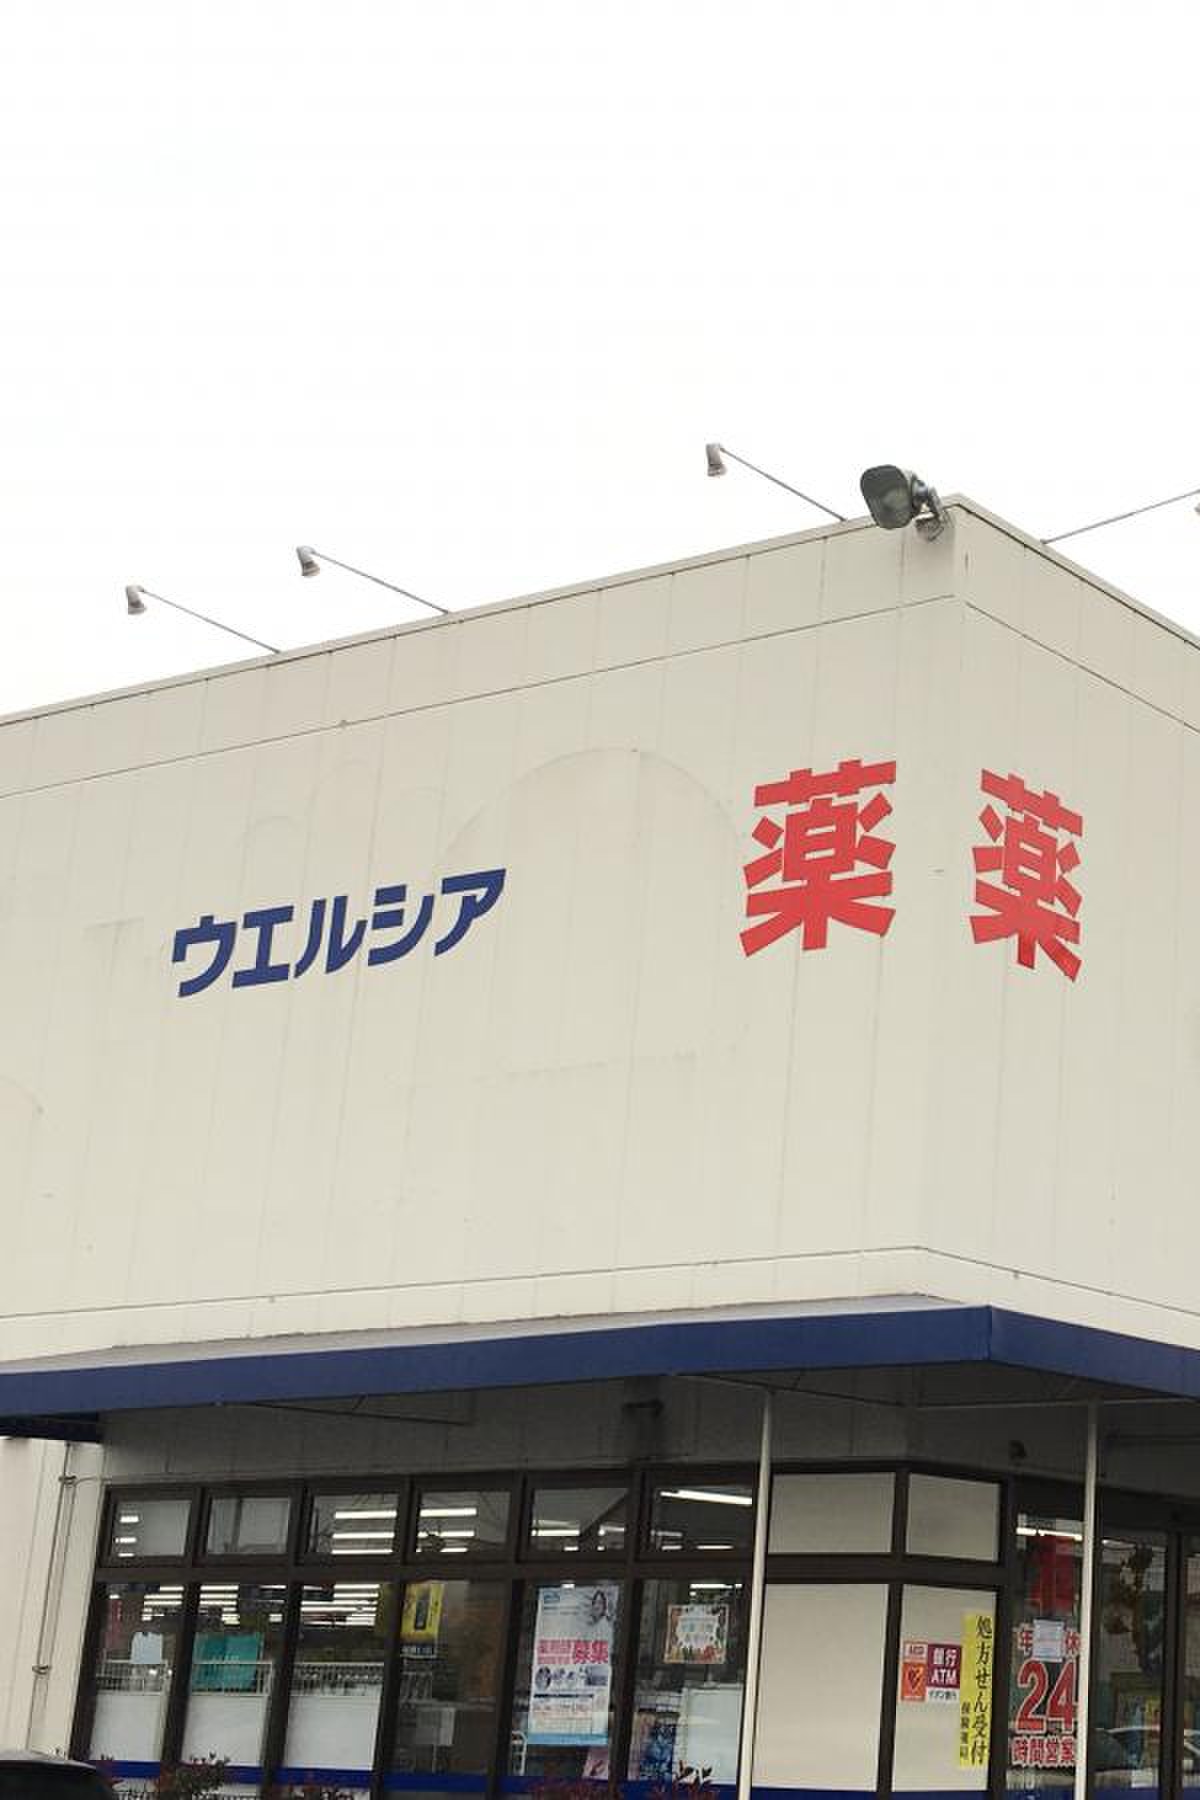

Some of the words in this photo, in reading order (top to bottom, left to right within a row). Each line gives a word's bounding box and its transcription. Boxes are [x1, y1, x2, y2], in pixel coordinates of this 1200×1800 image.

[739, 759, 896, 957] 薬
[969, 768, 1083, 982] 薬
[172, 868, 506, 997] ウエルシア
[930, 1668, 958, 1686] ATM
[933, 1647, 957, 1668] 銀行
[972, 1615, 993, 1765] 処方せん受付
[1016, 1657, 1078, 1734] 24
[1012, 1735, 1077, 1767] 時間営業
